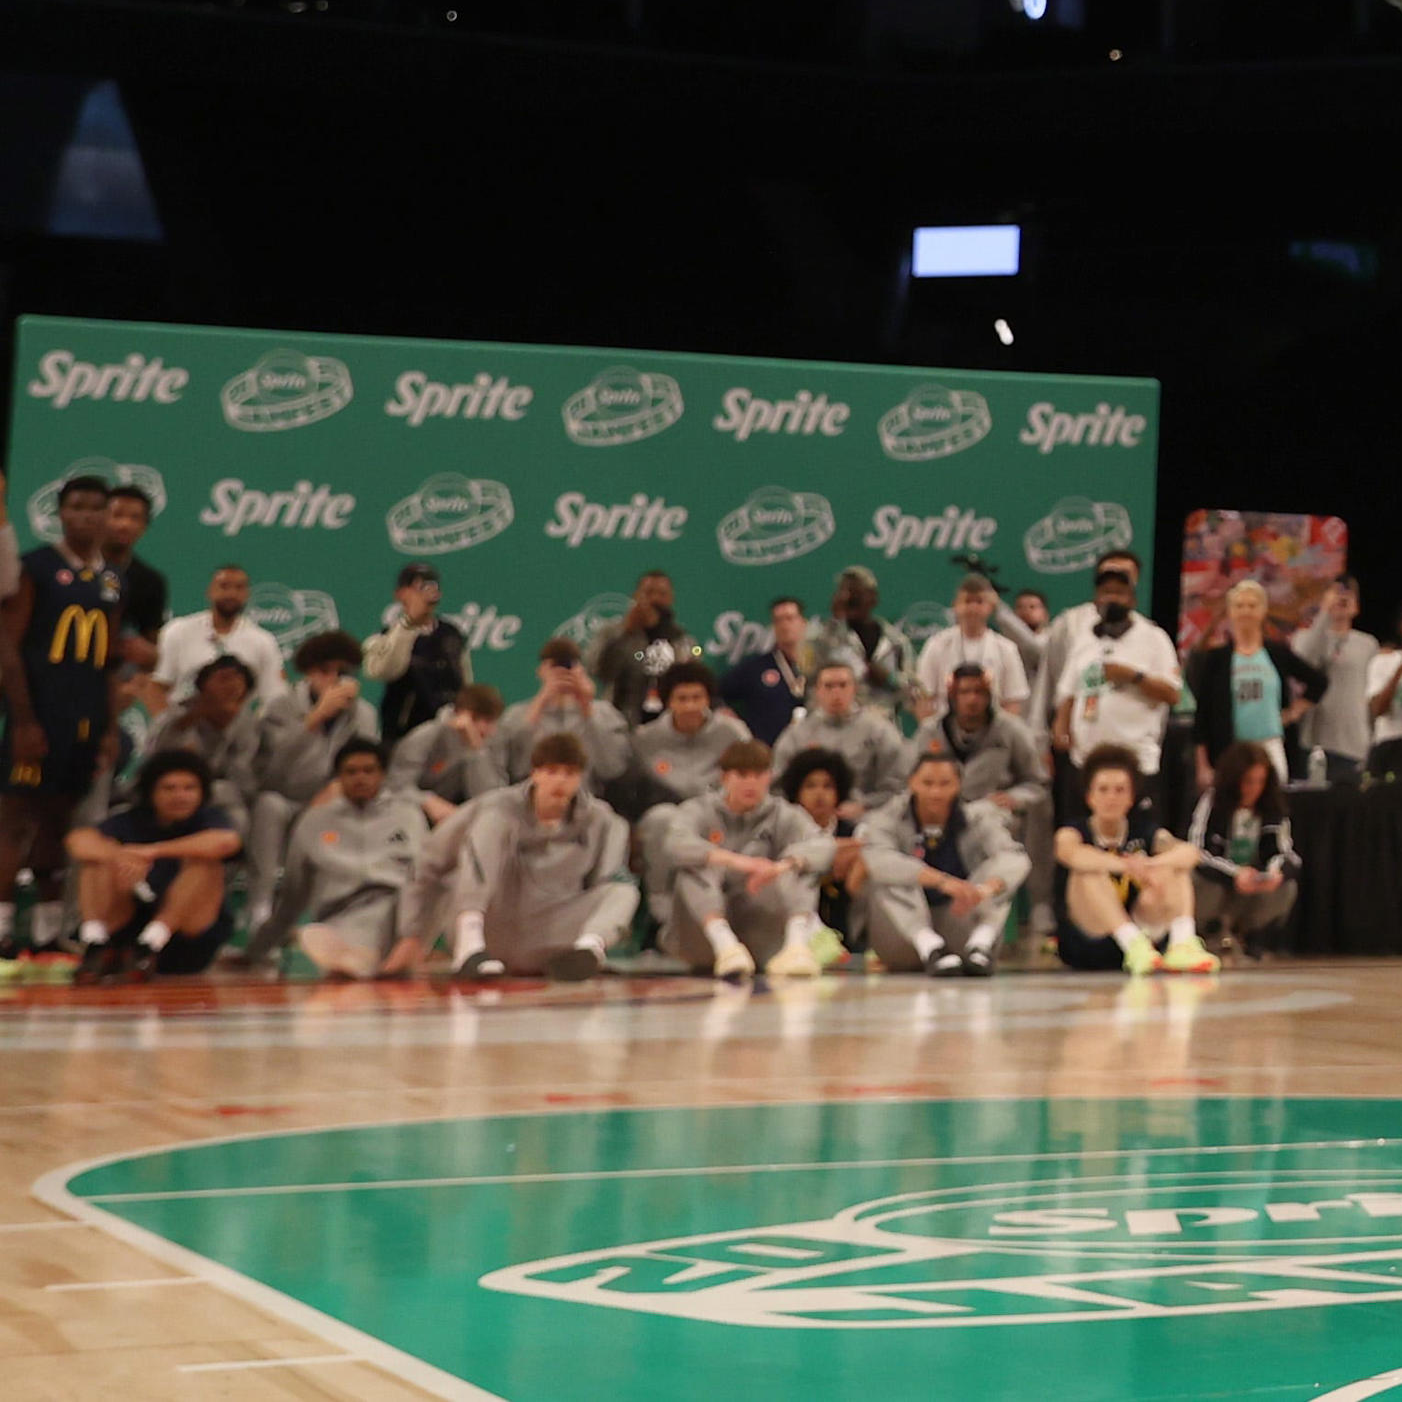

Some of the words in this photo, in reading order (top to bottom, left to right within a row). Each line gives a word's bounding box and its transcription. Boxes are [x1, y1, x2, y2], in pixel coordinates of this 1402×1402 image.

[27, 348, 190, 410] Sprite
[384, 370, 535, 427] Sprite
[712, 386, 852, 442] Sprite
[1018, 401, 1148, 455] Sprite
[199, 477, 357, 537] Sprite
[544, 490, 690, 548] Sprite
[863, 503, 998, 559] Sprite
